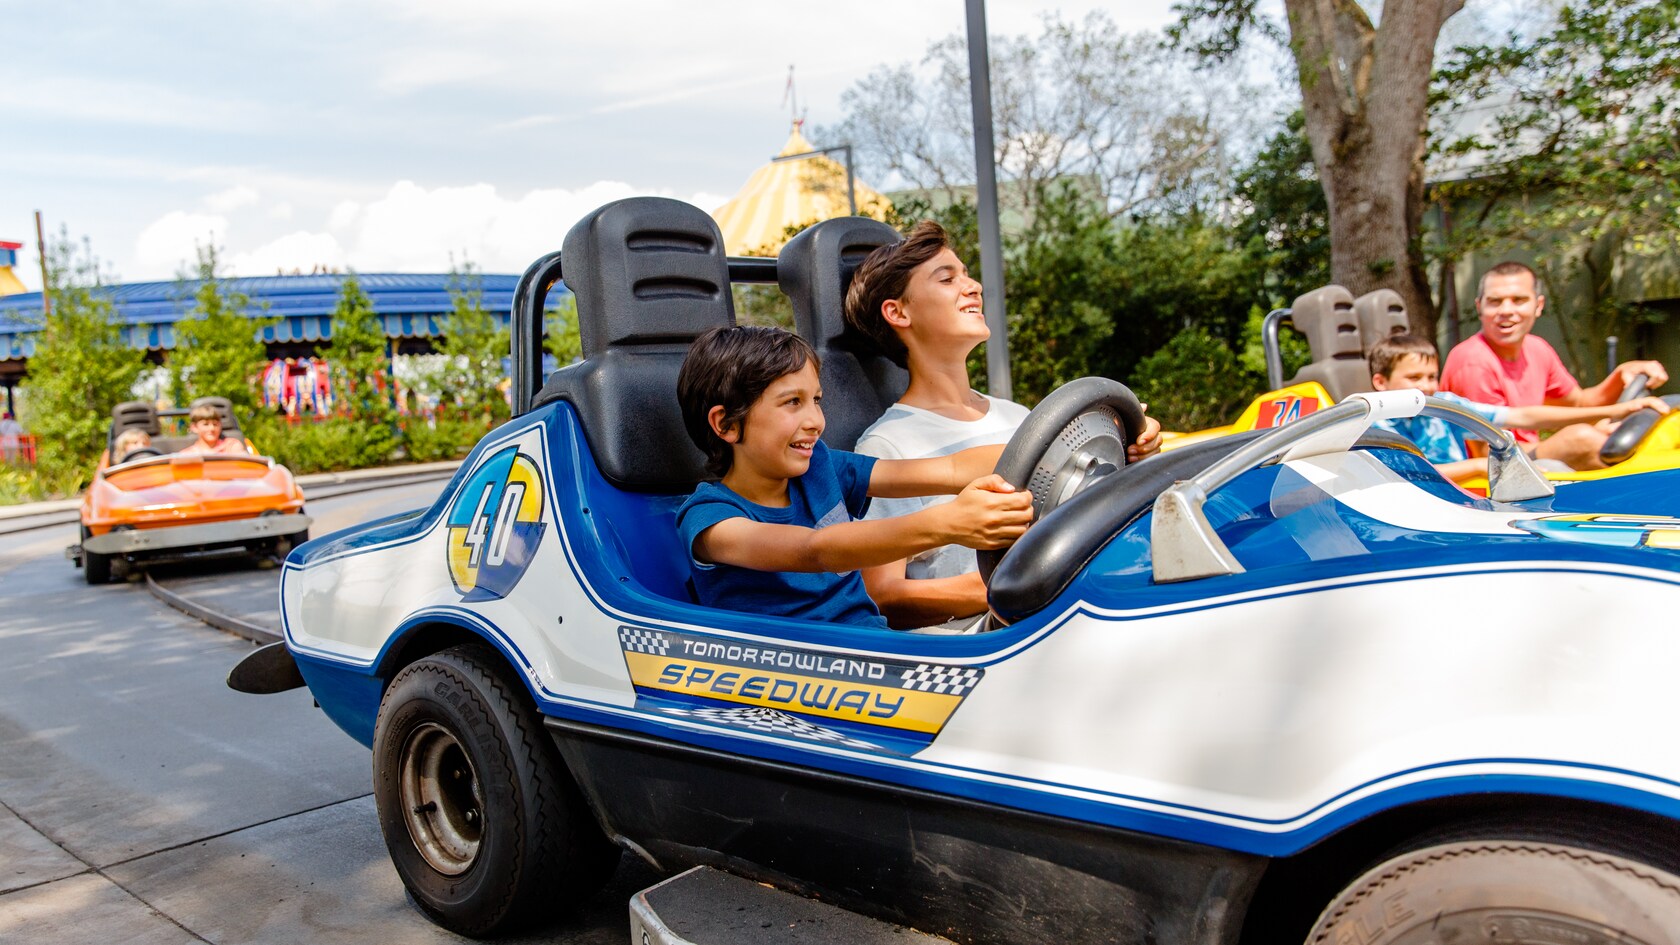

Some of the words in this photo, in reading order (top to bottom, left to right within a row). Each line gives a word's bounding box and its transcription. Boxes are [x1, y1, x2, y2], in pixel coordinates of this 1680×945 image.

[465, 483, 527, 568] 40
[683, 639, 886, 680] TOMORROWLAND
[658, 663, 905, 719] SPEEDWAY
